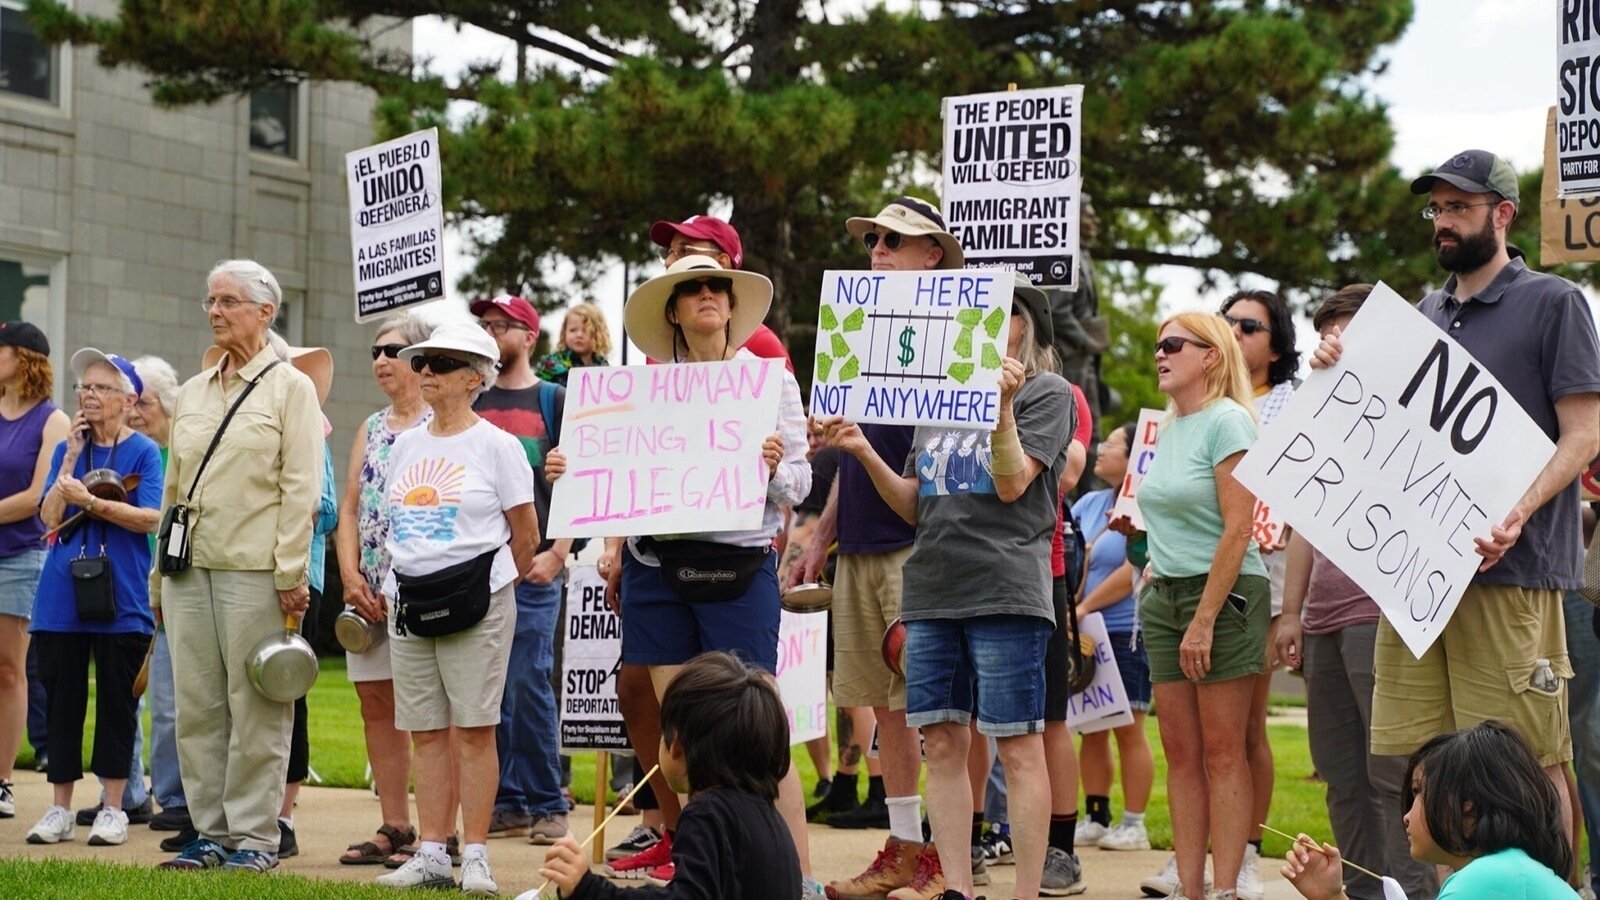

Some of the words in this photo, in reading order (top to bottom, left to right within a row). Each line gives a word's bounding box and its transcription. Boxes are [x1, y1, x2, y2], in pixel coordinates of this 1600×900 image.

[954, 102, 990, 126] THE
[995, 97, 1073, 122] PEOPLE
[379, 140, 430, 173] PUEBLO
[953, 122, 1071, 164] UNITED
[363, 163, 425, 207] UNIDO
[951, 163, 992, 184] WILL
[996, 159, 1070, 181] DEFEND
[1563, 161, 1583, 176] PARTY
[1583, 159, 1599, 174] FOR
[360, 189, 431, 227] DEFENDERÁ
[949, 196, 1071, 223] IMMIGRANT
[358, 248, 366, 262] A
[368, 242, 388, 259] LAS
[389, 228, 436, 253] FAMILIAS
[359, 245, 436, 282] MIGRANTES!
[1017, 261, 1034, 271] and
[836, 276, 886, 306] NOT
[915, 276, 994, 309] HERE
[579, 369, 634, 407] NO
[650, 360, 770, 405] HUMAN
[1398, 338, 1498, 455] NO
[813, 384, 852, 417] NOT
[864, 387, 998, 422] ANYWHERE
[572, 424, 687, 458] BEING
[708, 418, 742, 452] IS
[1313, 370, 1487, 557] PRIVATE
[569, 453, 766, 527] ILLEGAL!
[1266, 432, 1453, 632] PRISONS!
[566, 669, 607, 695] STOP
